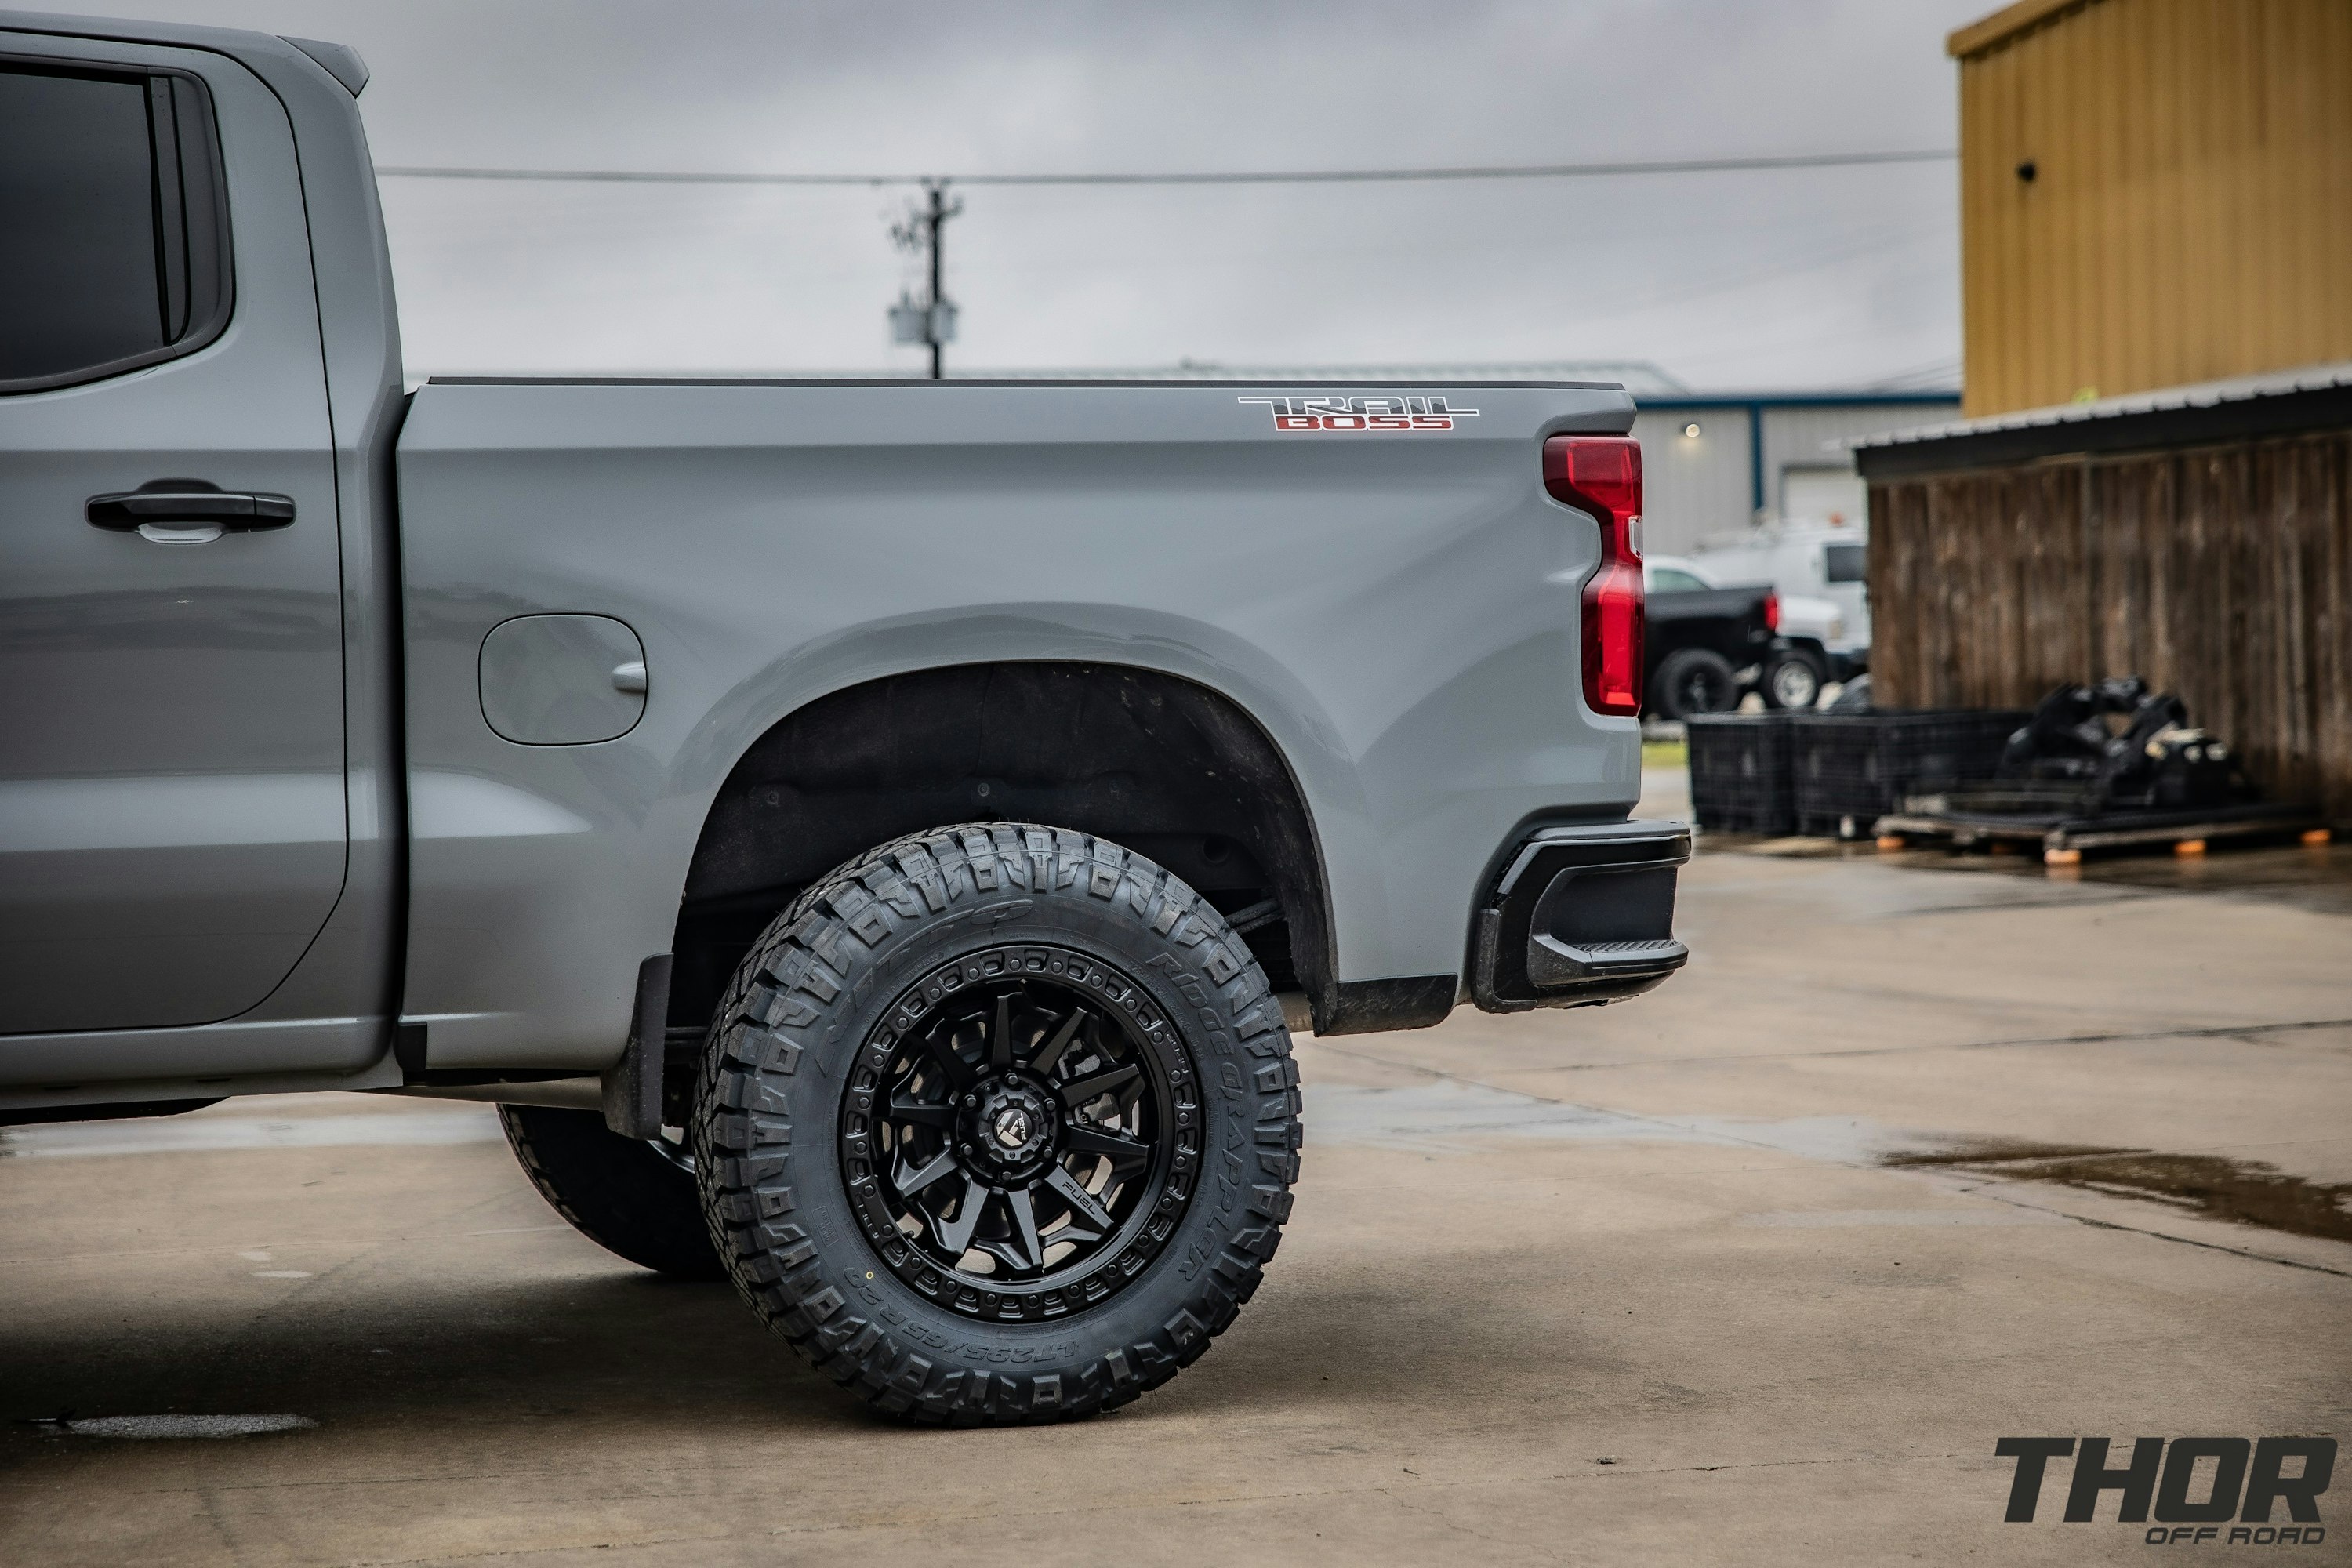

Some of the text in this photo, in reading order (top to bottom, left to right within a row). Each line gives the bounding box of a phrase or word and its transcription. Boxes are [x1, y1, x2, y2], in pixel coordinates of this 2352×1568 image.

[1237, 396, 1480, 416] TRAIL
[1275, 415, 1454, 432] BOSS
[1018, 1112, 1027, 1141] FUEL
[1145, 953, 1245, 1280] RIDGE GRAPPLER
[1062, 1181, 1095, 1215] FUEL
